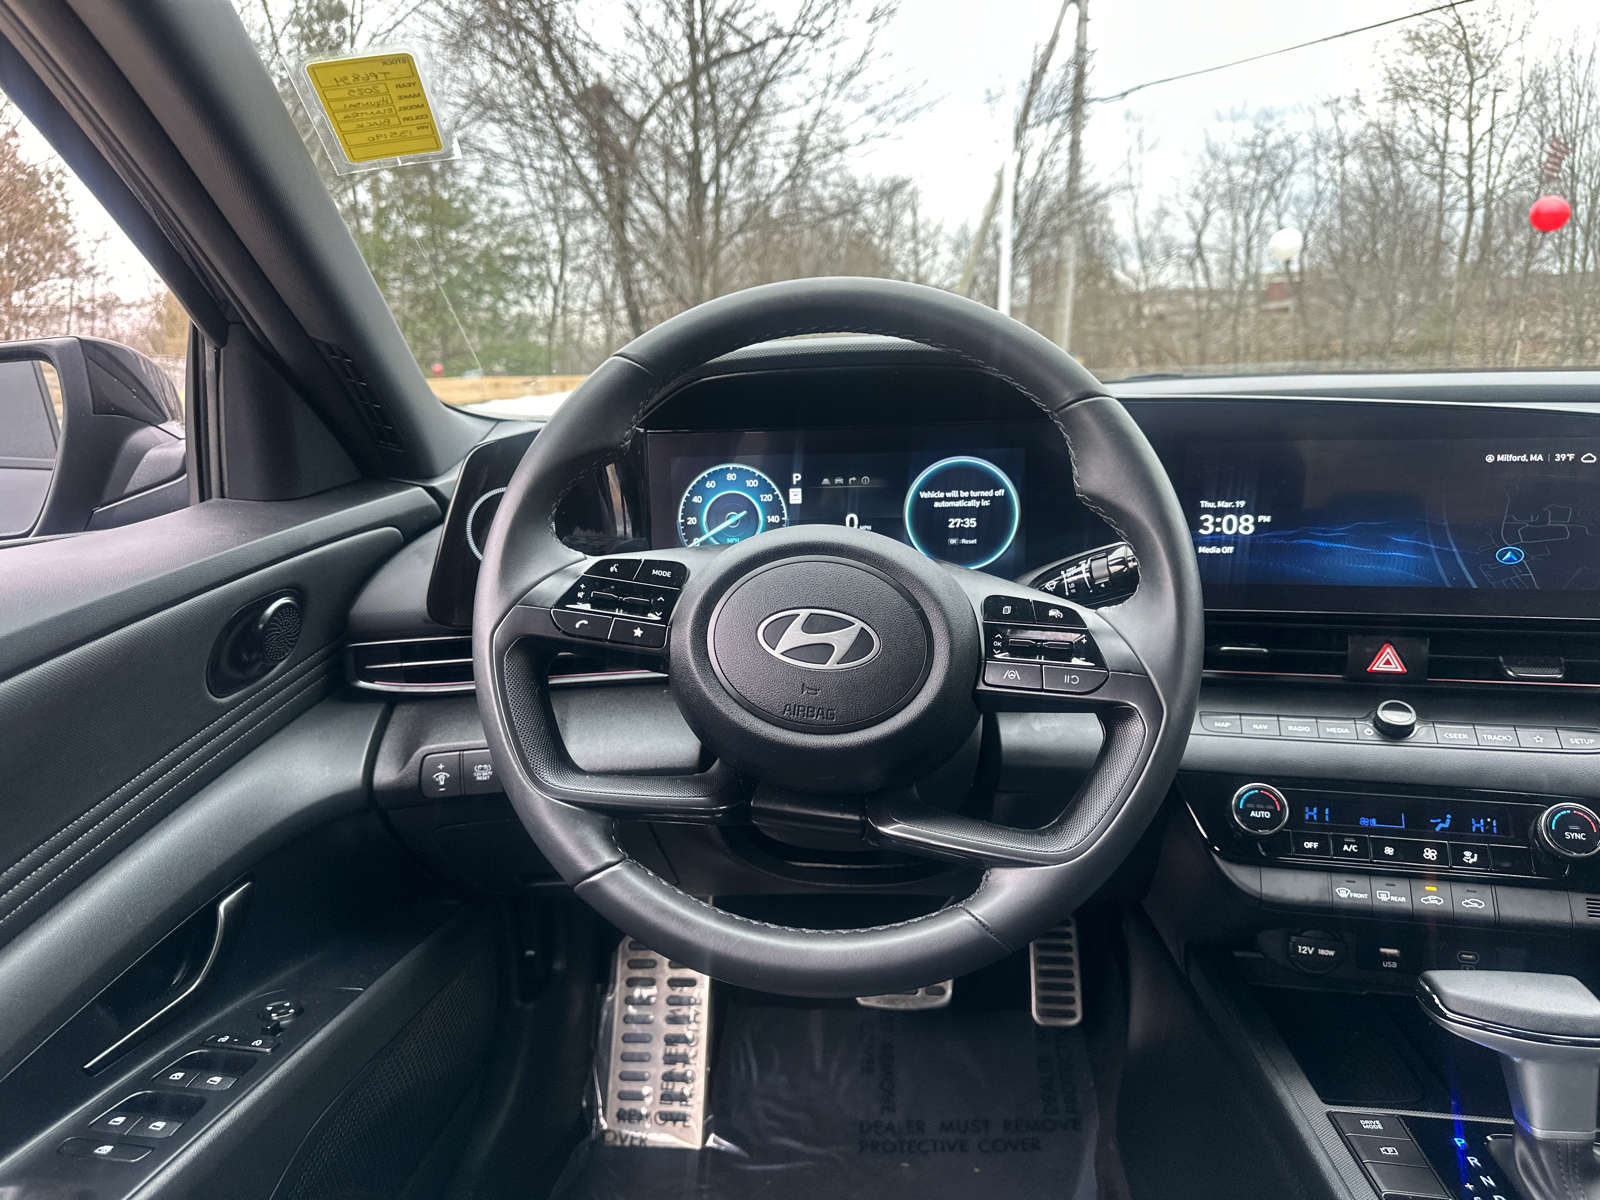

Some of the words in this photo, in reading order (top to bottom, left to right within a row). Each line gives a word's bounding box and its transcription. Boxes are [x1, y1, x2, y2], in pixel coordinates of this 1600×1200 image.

[1496, 454, 1528, 462] Milford,
[1530, 454, 1544, 462] MA
[727, 473, 737, 481] 80
[792, 473, 802, 484] P
[746, 479, 758, 487] 100
[760, 494, 772, 502] 120
[919, 490, 944, 498] Vehicle
[946, 490, 958, 498] will
[970, 489, 994, 497] turned
[934, 500, 980, 508] automatically
[1236, 500, 1246, 508] 19
[687, 517, 697, 525] 20
[767, 515, 780, 523] 140
[845, 513, 858, 529] 0
[948, 518, 977, 528] 27:35
[1199, 514, 1255, 535] 3:08
[1198, 546, 1220, 554] Media
[1221, 546, 1234, 554] Off
[652, 569, 672, 578] MODE
[782, 704, 836, 721] AIRBAG
[1564, 831, 1587, 840] SYNC
[1342, 844, 1358, 852] A/C
[1298, 945, 1314, 954] 12V
[1318, 949, 1335, 957] 180W
[859, 1119, 926, 1136] DEALER
[939, 1118, 991, 1134] MUST
[1003, 1117, 1082, 1133] REMOVE
[859, 1139, 968, 1154] PROTECTIVE
[978, 1137, 1041, 1152] COVER
[1454, 1138, 1466, 1148] P
[1467, 1156, 1482, 1168] R
[1480, 1176, 1496, 1187] N
